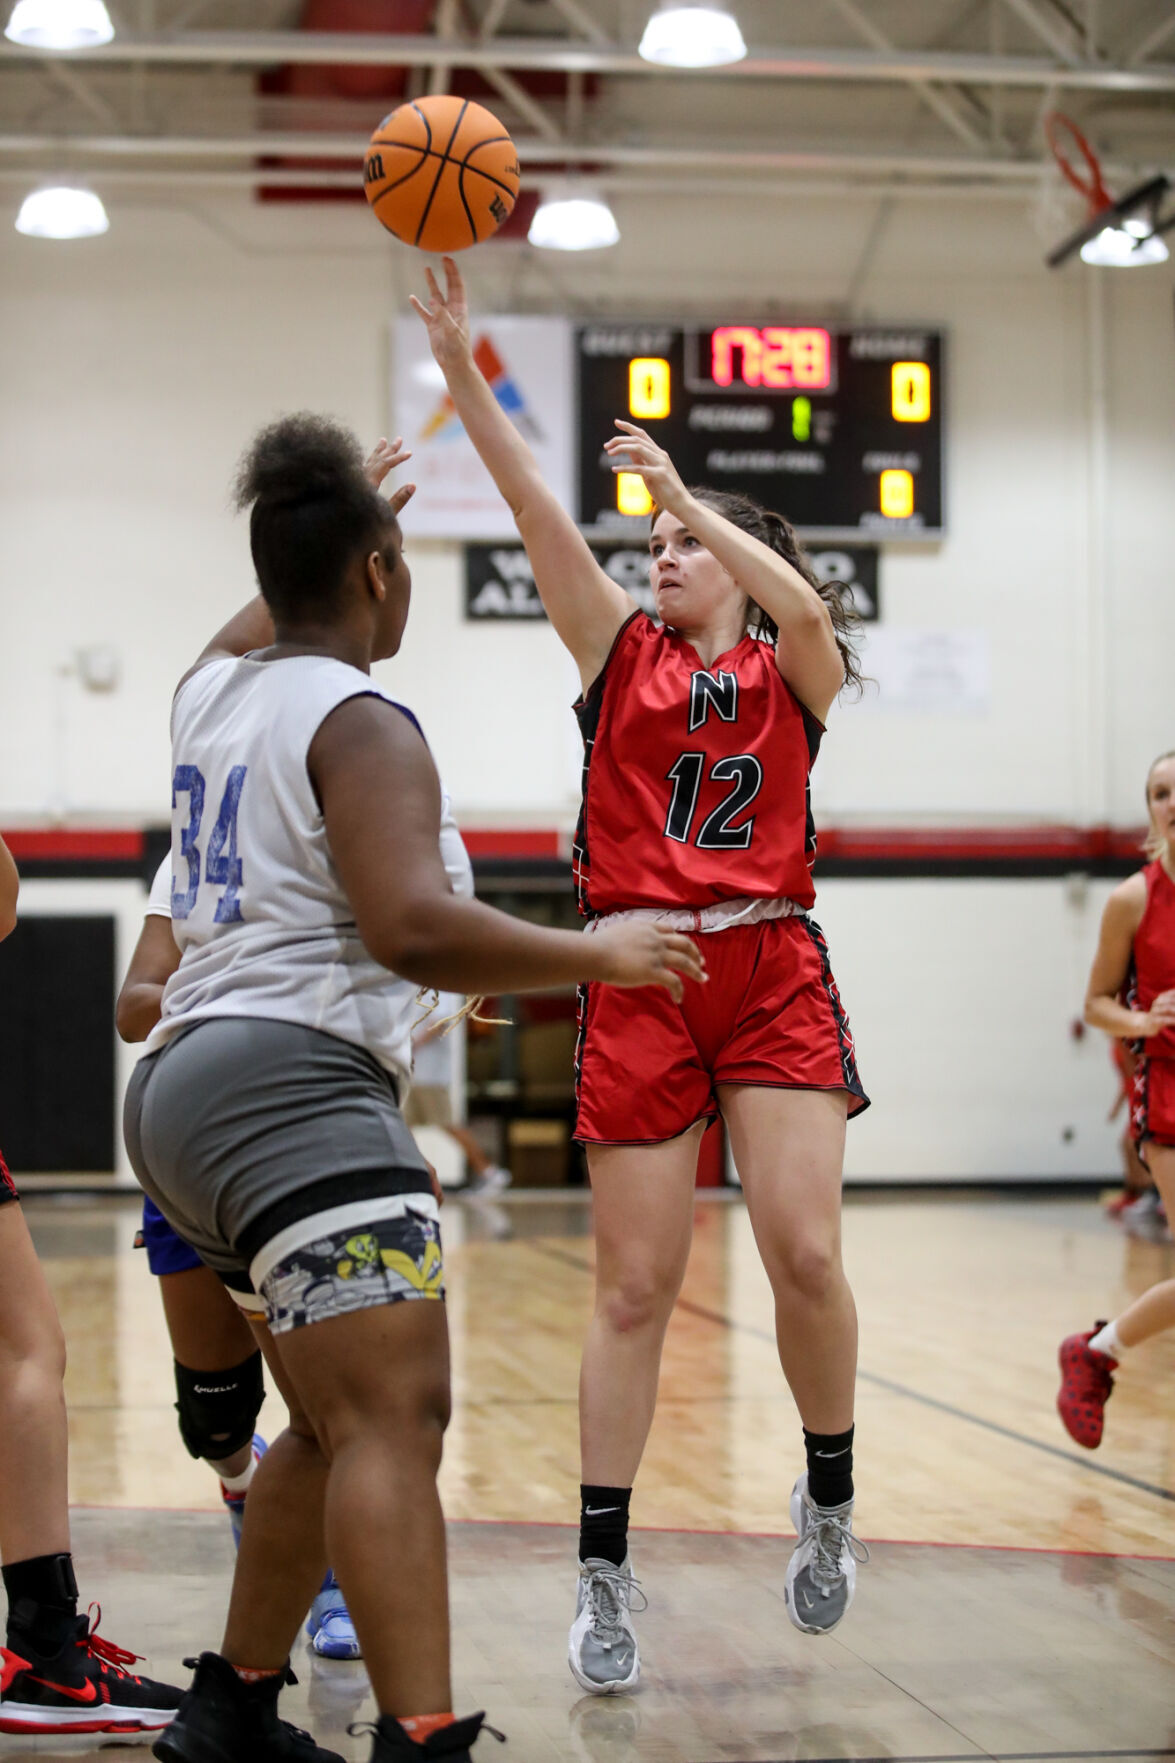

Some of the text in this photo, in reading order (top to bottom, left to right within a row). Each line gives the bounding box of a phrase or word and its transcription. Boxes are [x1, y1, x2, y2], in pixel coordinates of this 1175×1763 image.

[629, 358, 670, 419] 0
[891, 362, 930, 422] 0
[688, 669, 739, 735] N
[663, 752, 764, 849] 12
[171, 765, 248, 922] 34
